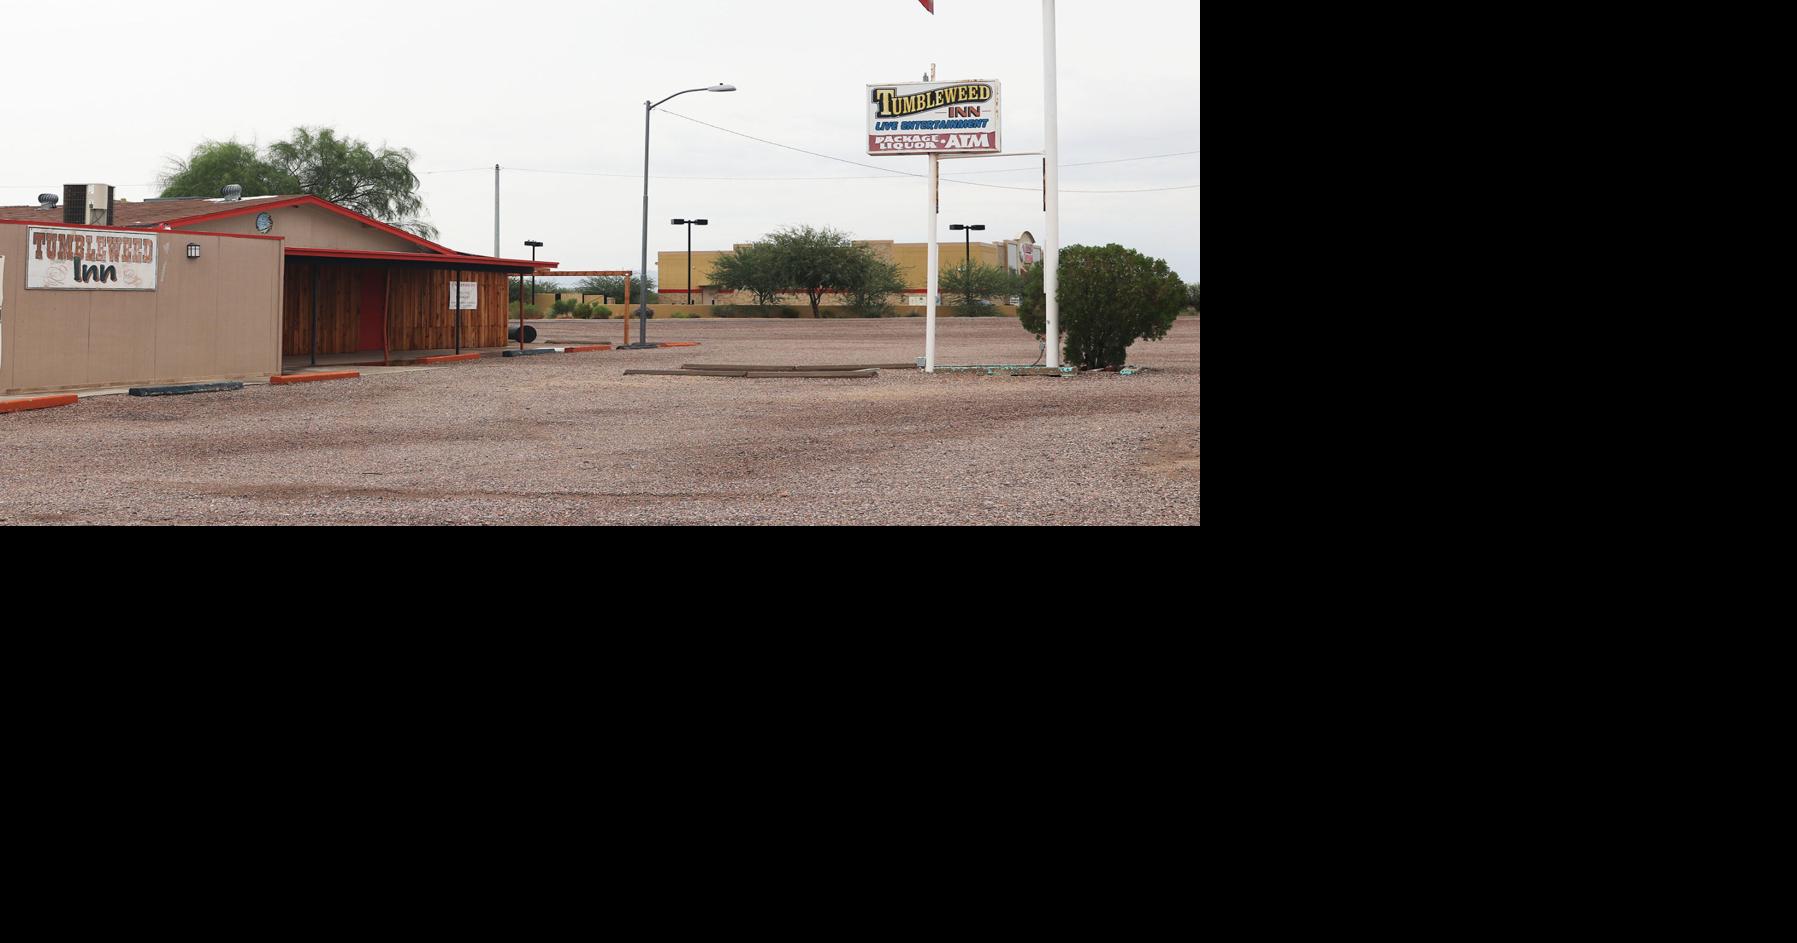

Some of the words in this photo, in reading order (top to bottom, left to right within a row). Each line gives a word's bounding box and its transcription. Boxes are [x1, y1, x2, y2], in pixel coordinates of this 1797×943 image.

[875, 85, 991, 117] TUMBLEWEED
[948, 106, 981, 118] INN
[875, 121, 899, 131] LIVE
[900, 119, 989, 130] ENTERTAINMENT
[875, 134, 939, 144] PACKAGE
[944, 133, 990, 148] ATM
[880, 142, 937, 150] LIQUOR
[33, 231, 153, 263] TUMBLEWEED
[73, 256, 117, 283] Inn
